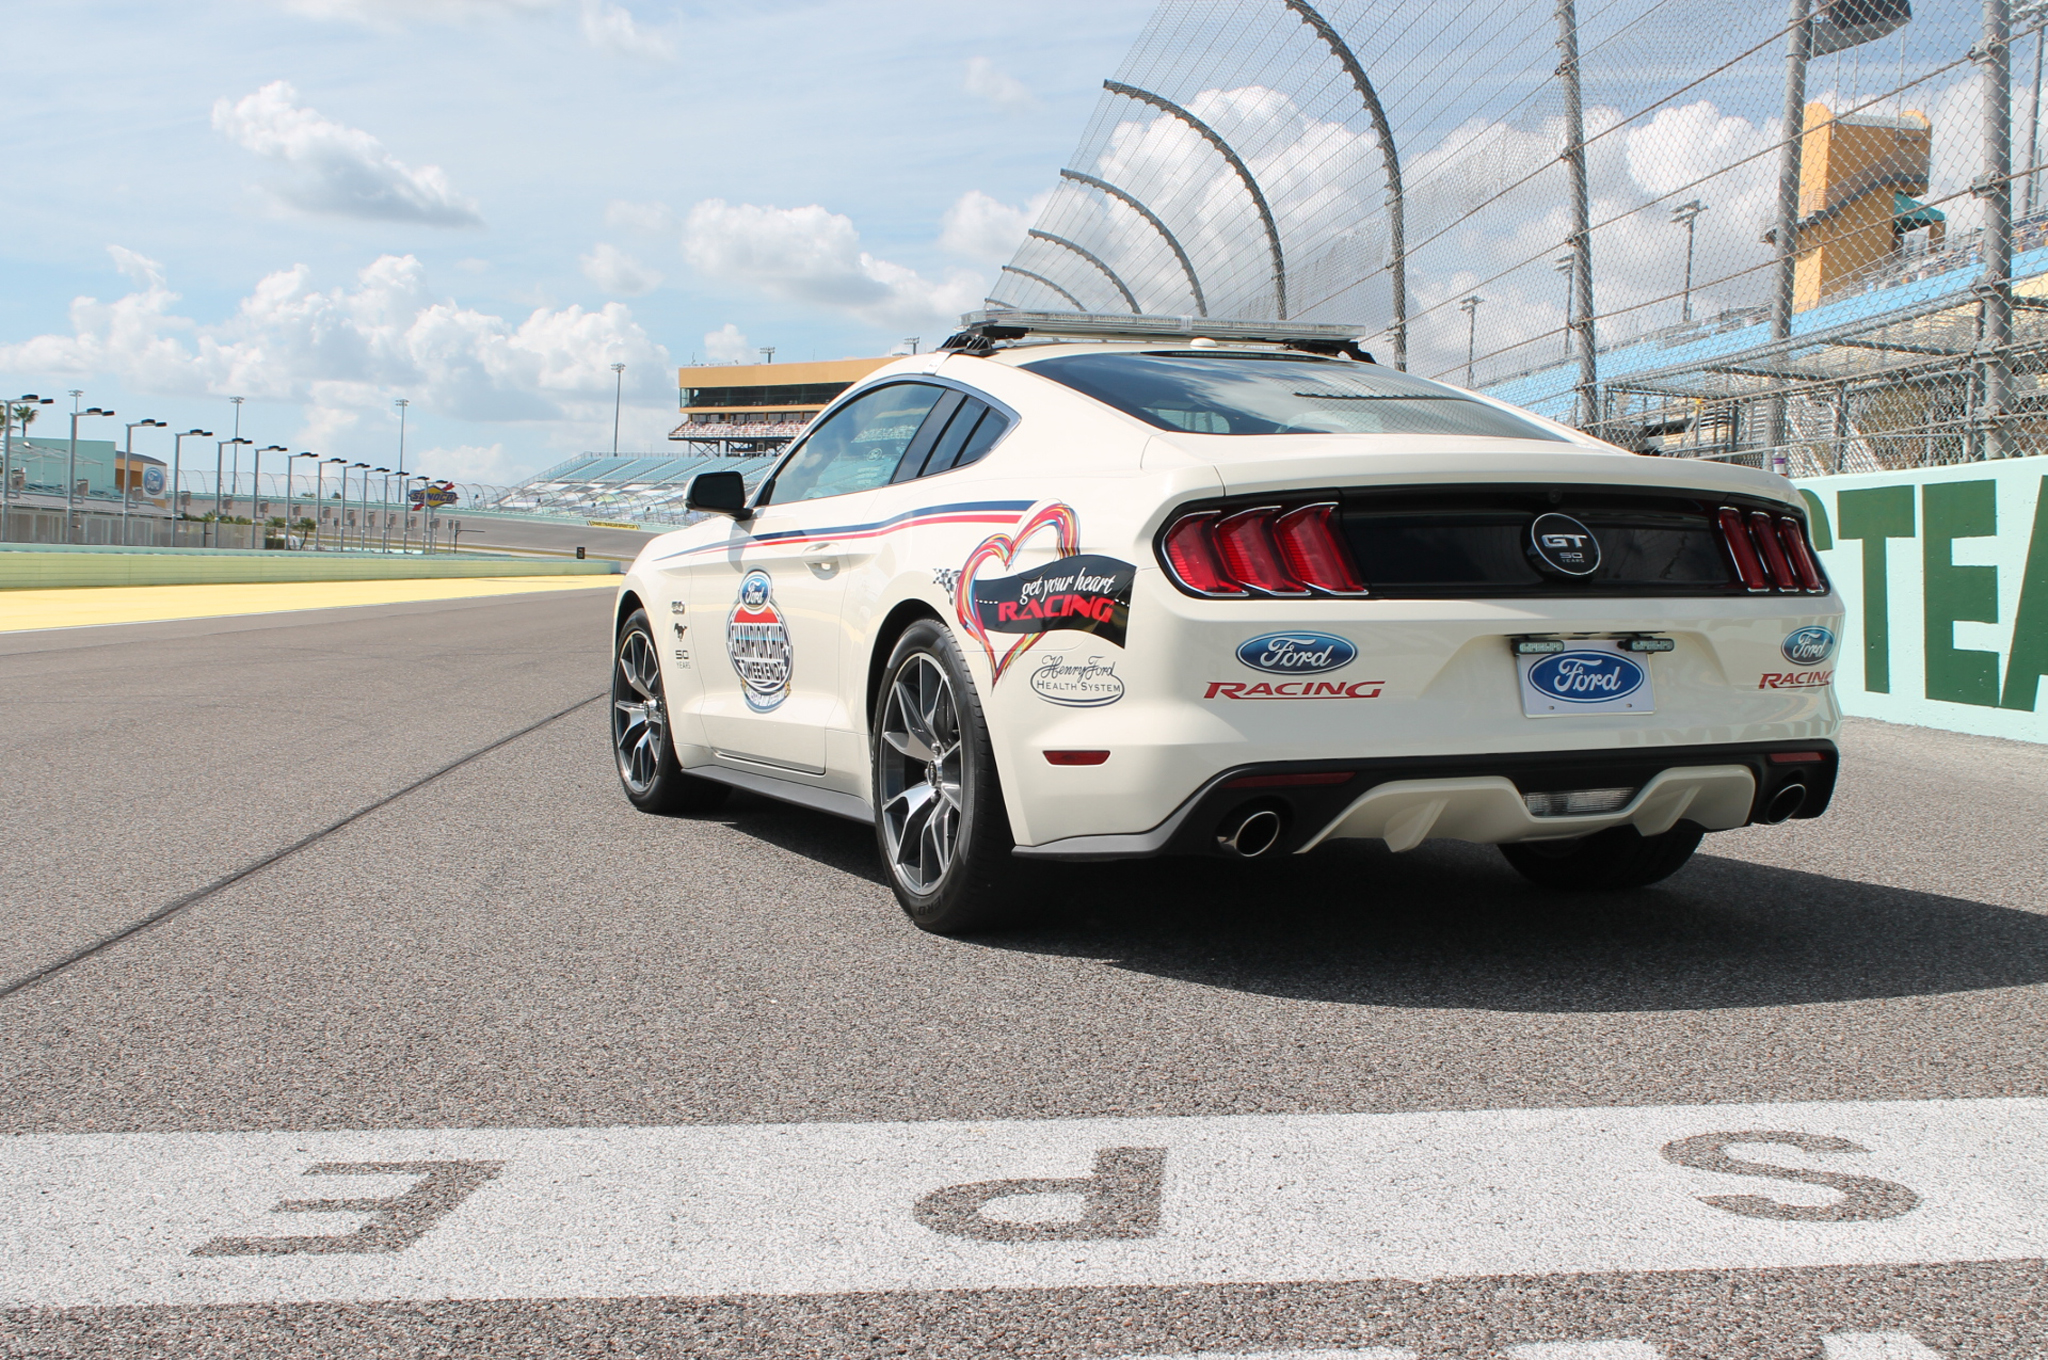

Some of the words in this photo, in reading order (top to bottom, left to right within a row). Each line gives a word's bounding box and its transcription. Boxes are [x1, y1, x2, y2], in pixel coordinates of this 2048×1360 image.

[412, 492, 454, 502] SUNOCO
[1541, 534, 1587, 547] GT
[745, 580, 765, 604] Ford
[1020, 577, 1043, 605] get
[1039, 576, 1074, 602] your
[1074, 567, 1116, 595] heart
[998, 594, 1116, 623] RACING
[731, 624, 786, 660] CHAMPIONSHIP
[1260, 637, 1335, 667] Ford
[1792, 631, 1828, 658] Ford
[675, 650, 689, 659] 50
[676, 661, 691, 670] YEARS
[745, 661, 781, 681] WEEKEND
[1040, 655, 1086, 684] Henry
[1084, 655, 1117, 681] Ford
[1553, 657, 1622, 692] Ford
[1036, 680, 1077, 691] HEALTH
[1081, 682, 1121, 692] SYSTEM
[1203, 681, 1385, 700] RACING
